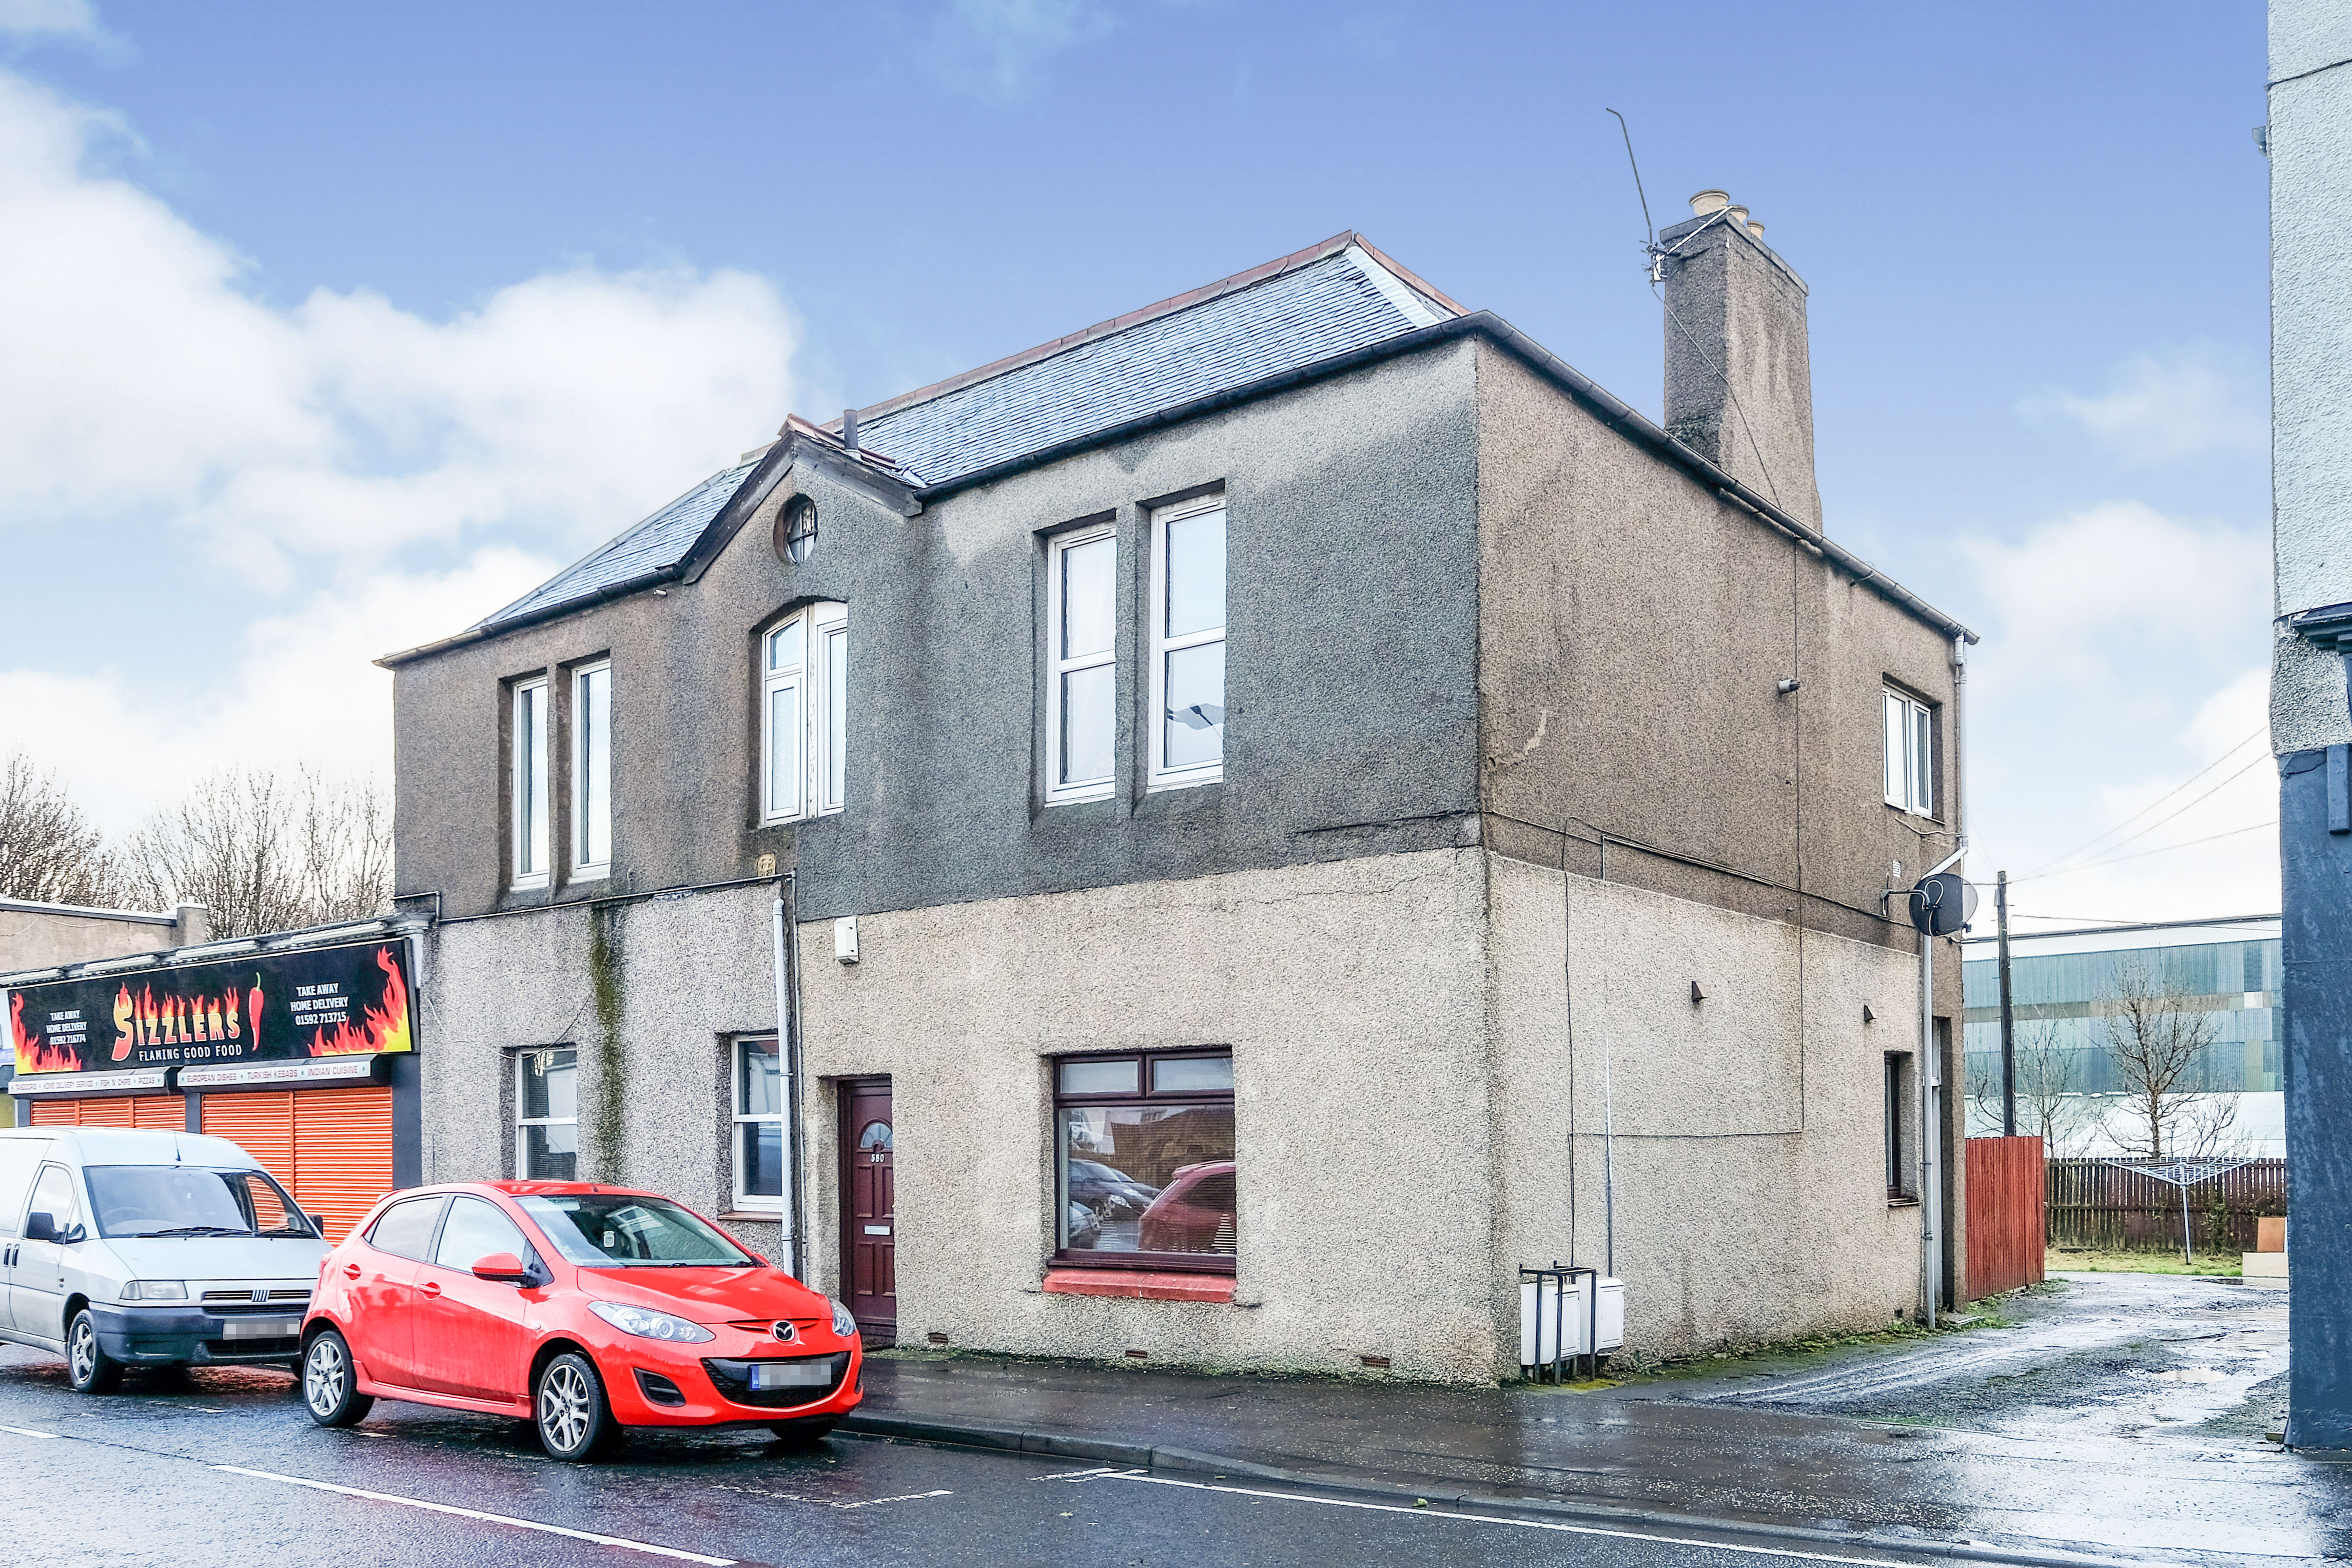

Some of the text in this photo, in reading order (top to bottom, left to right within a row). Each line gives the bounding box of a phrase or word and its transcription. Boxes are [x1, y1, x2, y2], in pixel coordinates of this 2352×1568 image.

[296, 983, 339, 997] TAKE AWAY
[290, 996, 349, 1012] HOME DELIVERY
[49, 1010, 80, 1022] TAKE AWAY
[295, 1011, 347, 1026] 01592 713715
[46, 1021, 87, 1034] HOME DELIVERY
[111, 993, 241, 1062] SIZZLERS
[139, 1044, 242, 1062] FLAMING GOOD FOOD
[187, 1065, 358, 1083] EUROPEAN DISHES TURKISH KEBABS INDIAN CUISINE
[871, 1153, 885, 1163] 580
